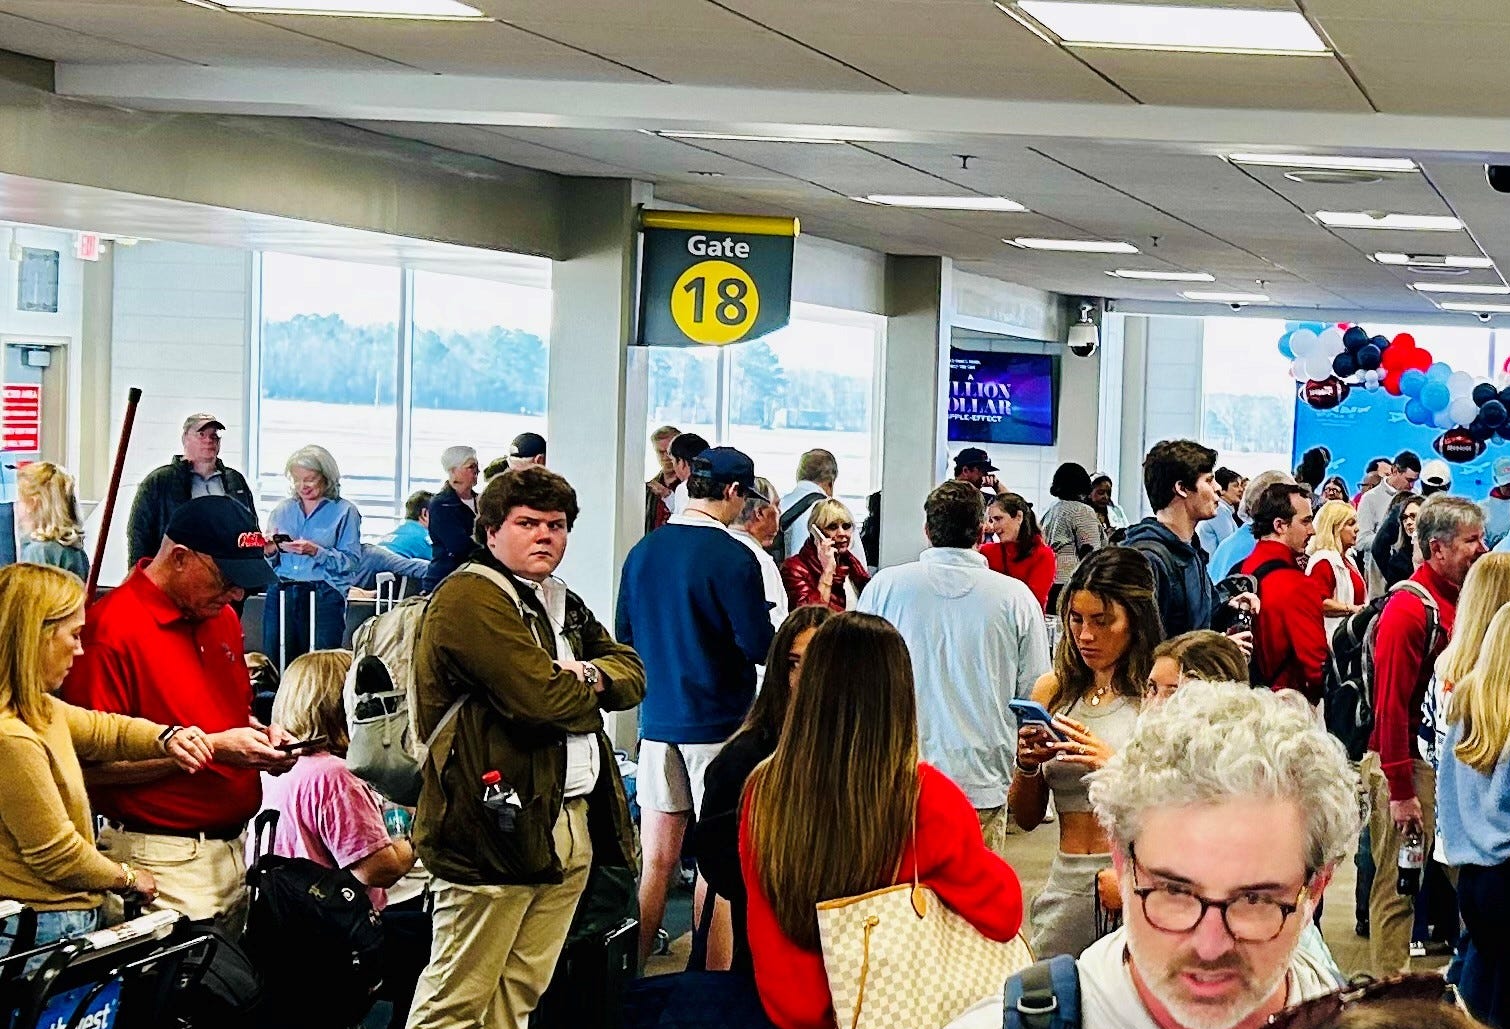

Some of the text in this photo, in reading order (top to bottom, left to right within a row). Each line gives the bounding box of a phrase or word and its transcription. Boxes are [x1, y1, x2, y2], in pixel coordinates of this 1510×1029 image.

[687, 235, 750, 258] Gate
[683, 277, 748, 326] 18
[952, 381, 1011, 399] LLION
[947, 397, 1012, 416] OLLAR
